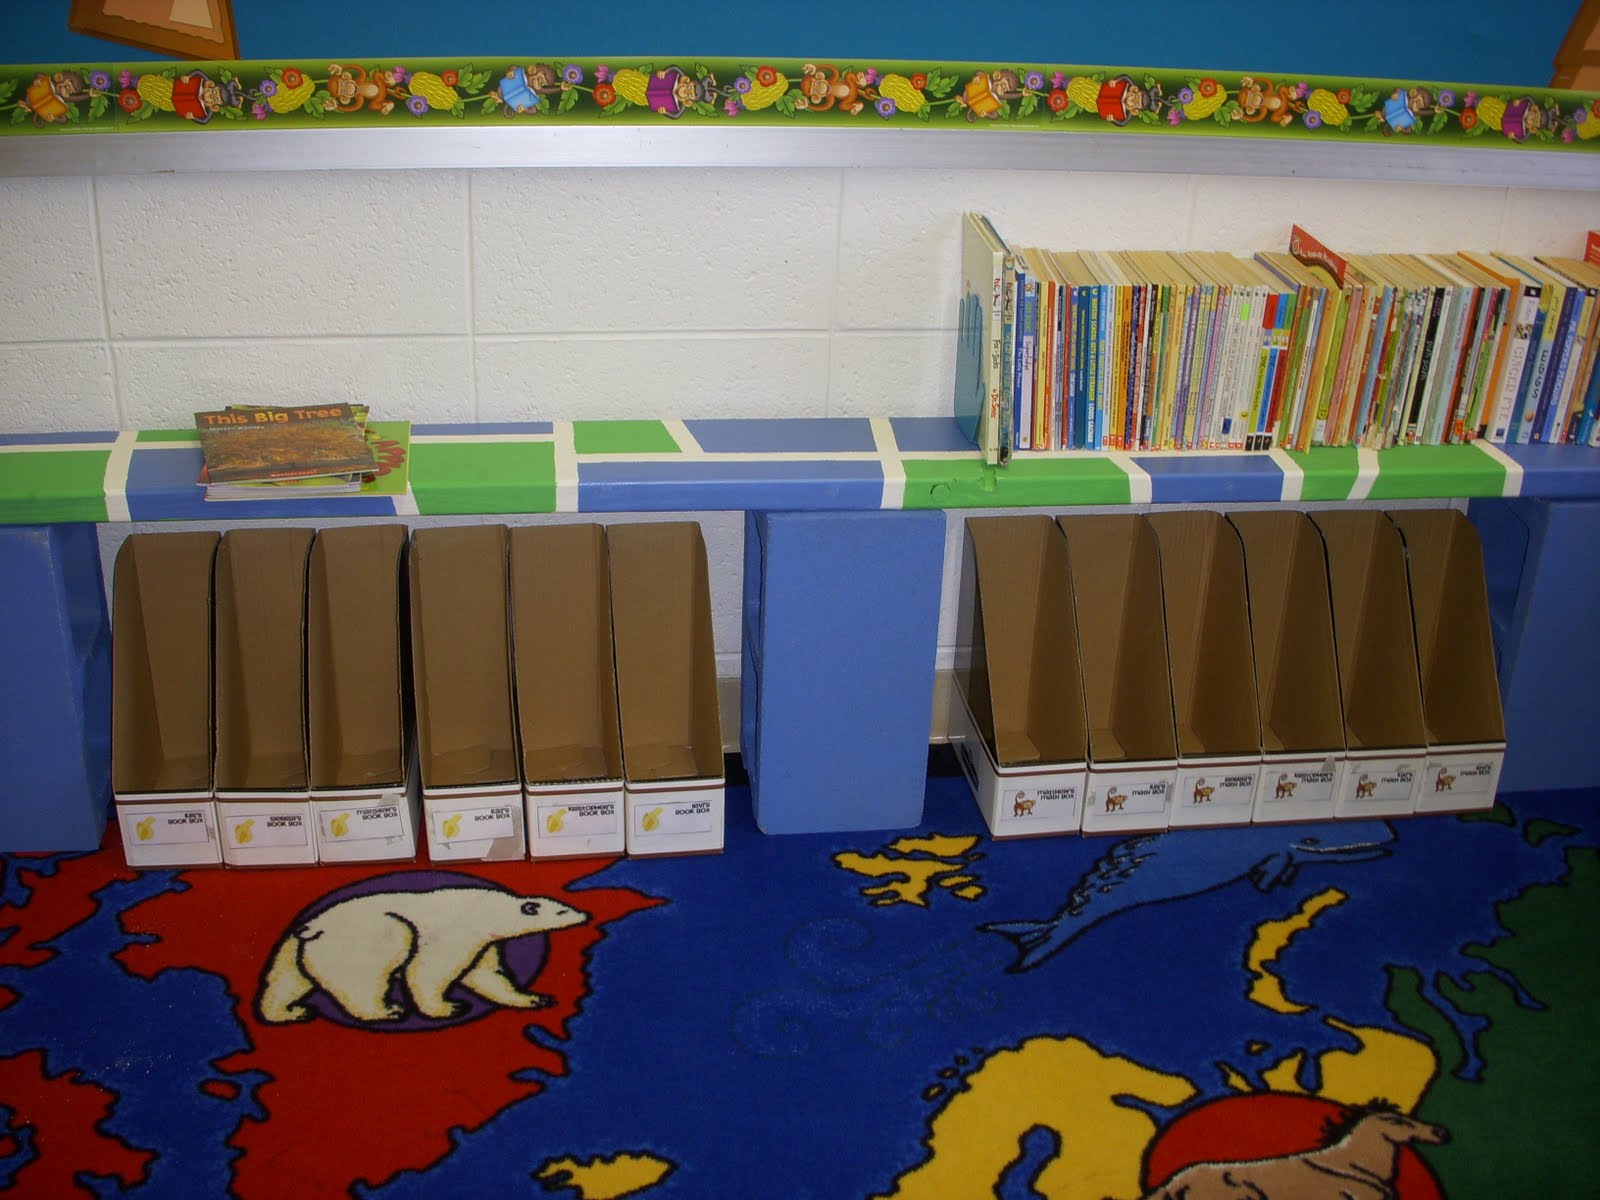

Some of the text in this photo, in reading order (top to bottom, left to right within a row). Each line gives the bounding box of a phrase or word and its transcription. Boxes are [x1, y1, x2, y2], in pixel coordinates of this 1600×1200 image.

[1499, 346, 1525, 424] GINGER PYE
[1532, 349, 1549, 400] EGGS
[204, 408, 342, 426] This Big Tree
